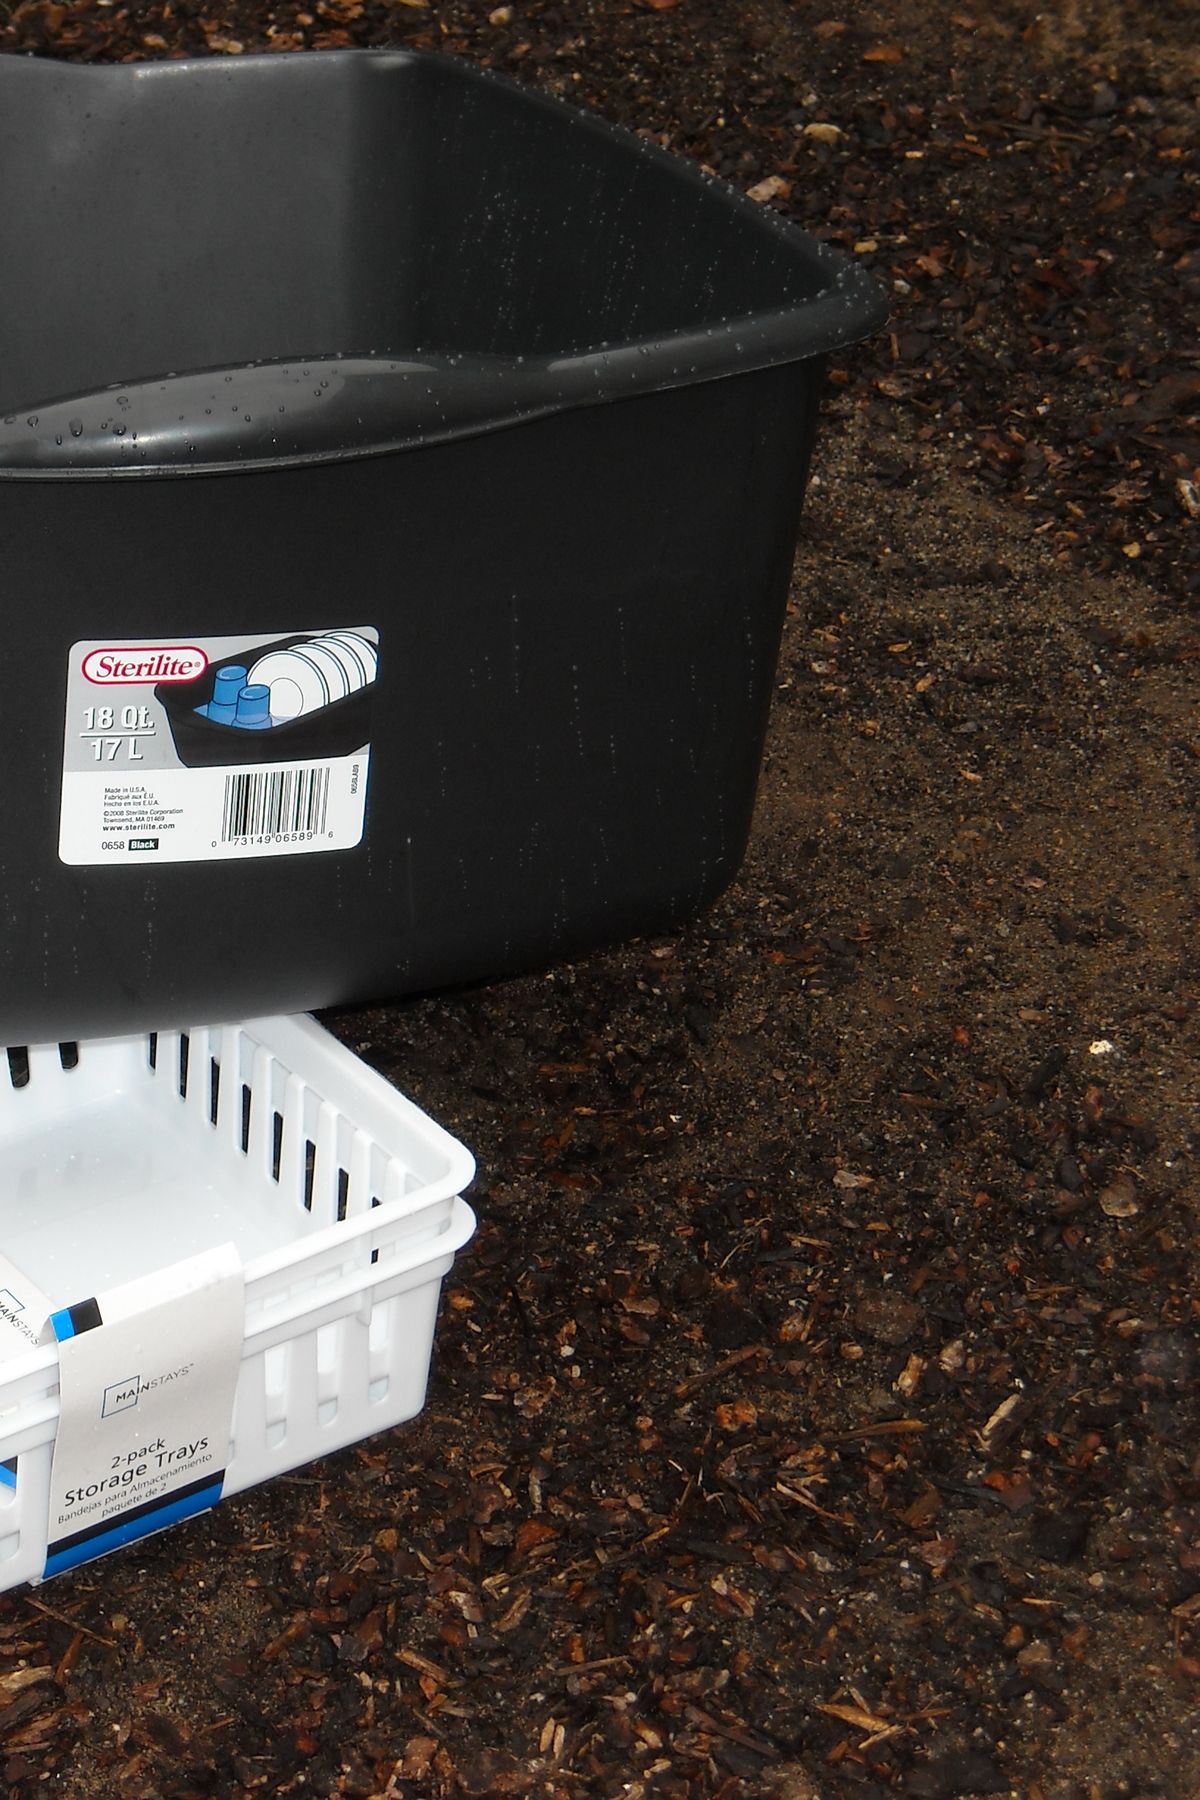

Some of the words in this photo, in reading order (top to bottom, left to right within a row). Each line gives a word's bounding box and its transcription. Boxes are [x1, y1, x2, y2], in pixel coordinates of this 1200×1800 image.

[83, 705, 114, 730] 18
[121, 705, 155, 731] Qt.
[91, 737, 122, 761] 17
[128, 737, 143, 760] L
[149, 808, 184, 816] Corporation
[102, 823, 175, 832] www.sterilite.com
[211, 840, 217, 848] 0
[233, 834, 271, 846] 73149
[275, 831, 313, 843] 06589
[327, 830, 334, 839] 6
[101, 841, 125, 850] 0658
[130, 840, 156, 850] Black
[110, 1438, 166, 1470] 2-pack
[64, 1463, 148, 1507] Storage
[154, 1437, 209, 1469] Trays
[57, 1501, 102, 1525] Bandejas
[104, 1491, 127, 1506] para
[129, 1453, 213, 1494] Almacenamiento
[100, 1496, 143, 1518] paquete
[144, 1486, 158, 1498] de
[160, 1482, 167, 1492] 2
